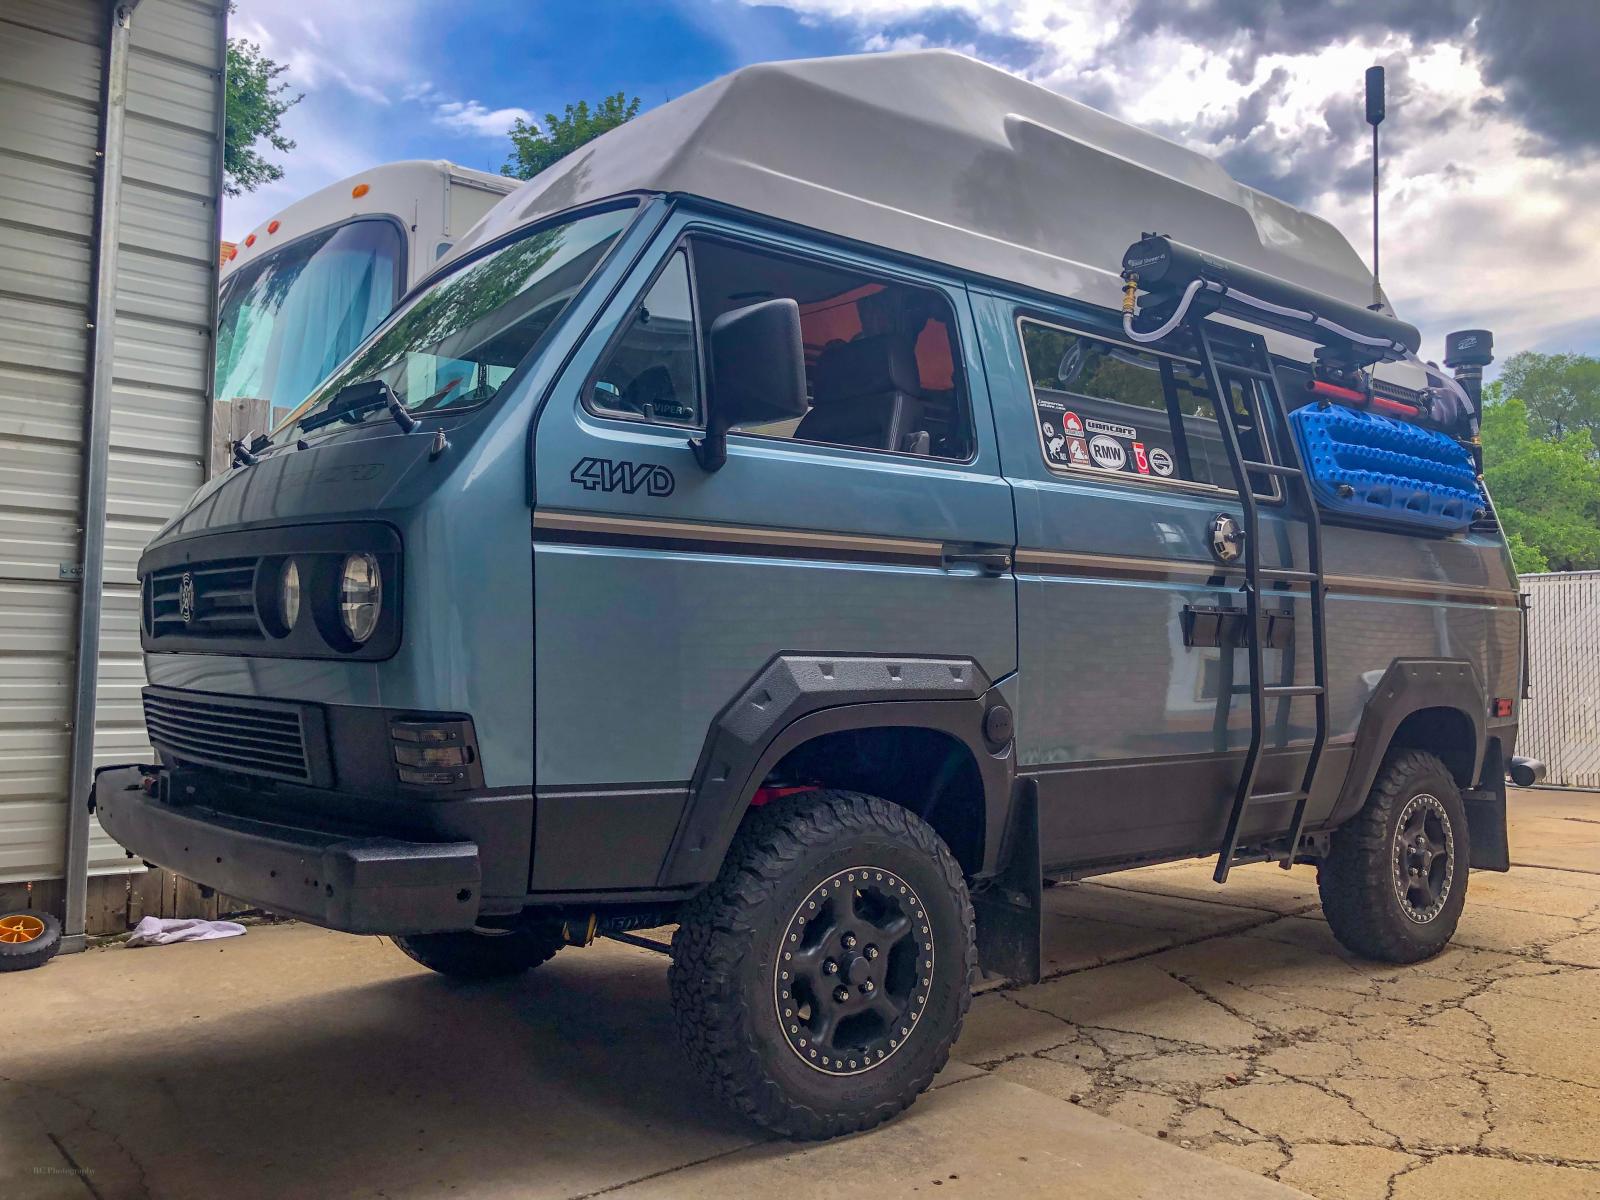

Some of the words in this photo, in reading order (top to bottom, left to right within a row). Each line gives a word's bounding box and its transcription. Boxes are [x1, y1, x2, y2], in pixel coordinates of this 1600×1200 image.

[654, 402, 683, 415] VIPER
[1093, 444, 1122, 461] RMW
[570, 457, 675, 497] 4WD
